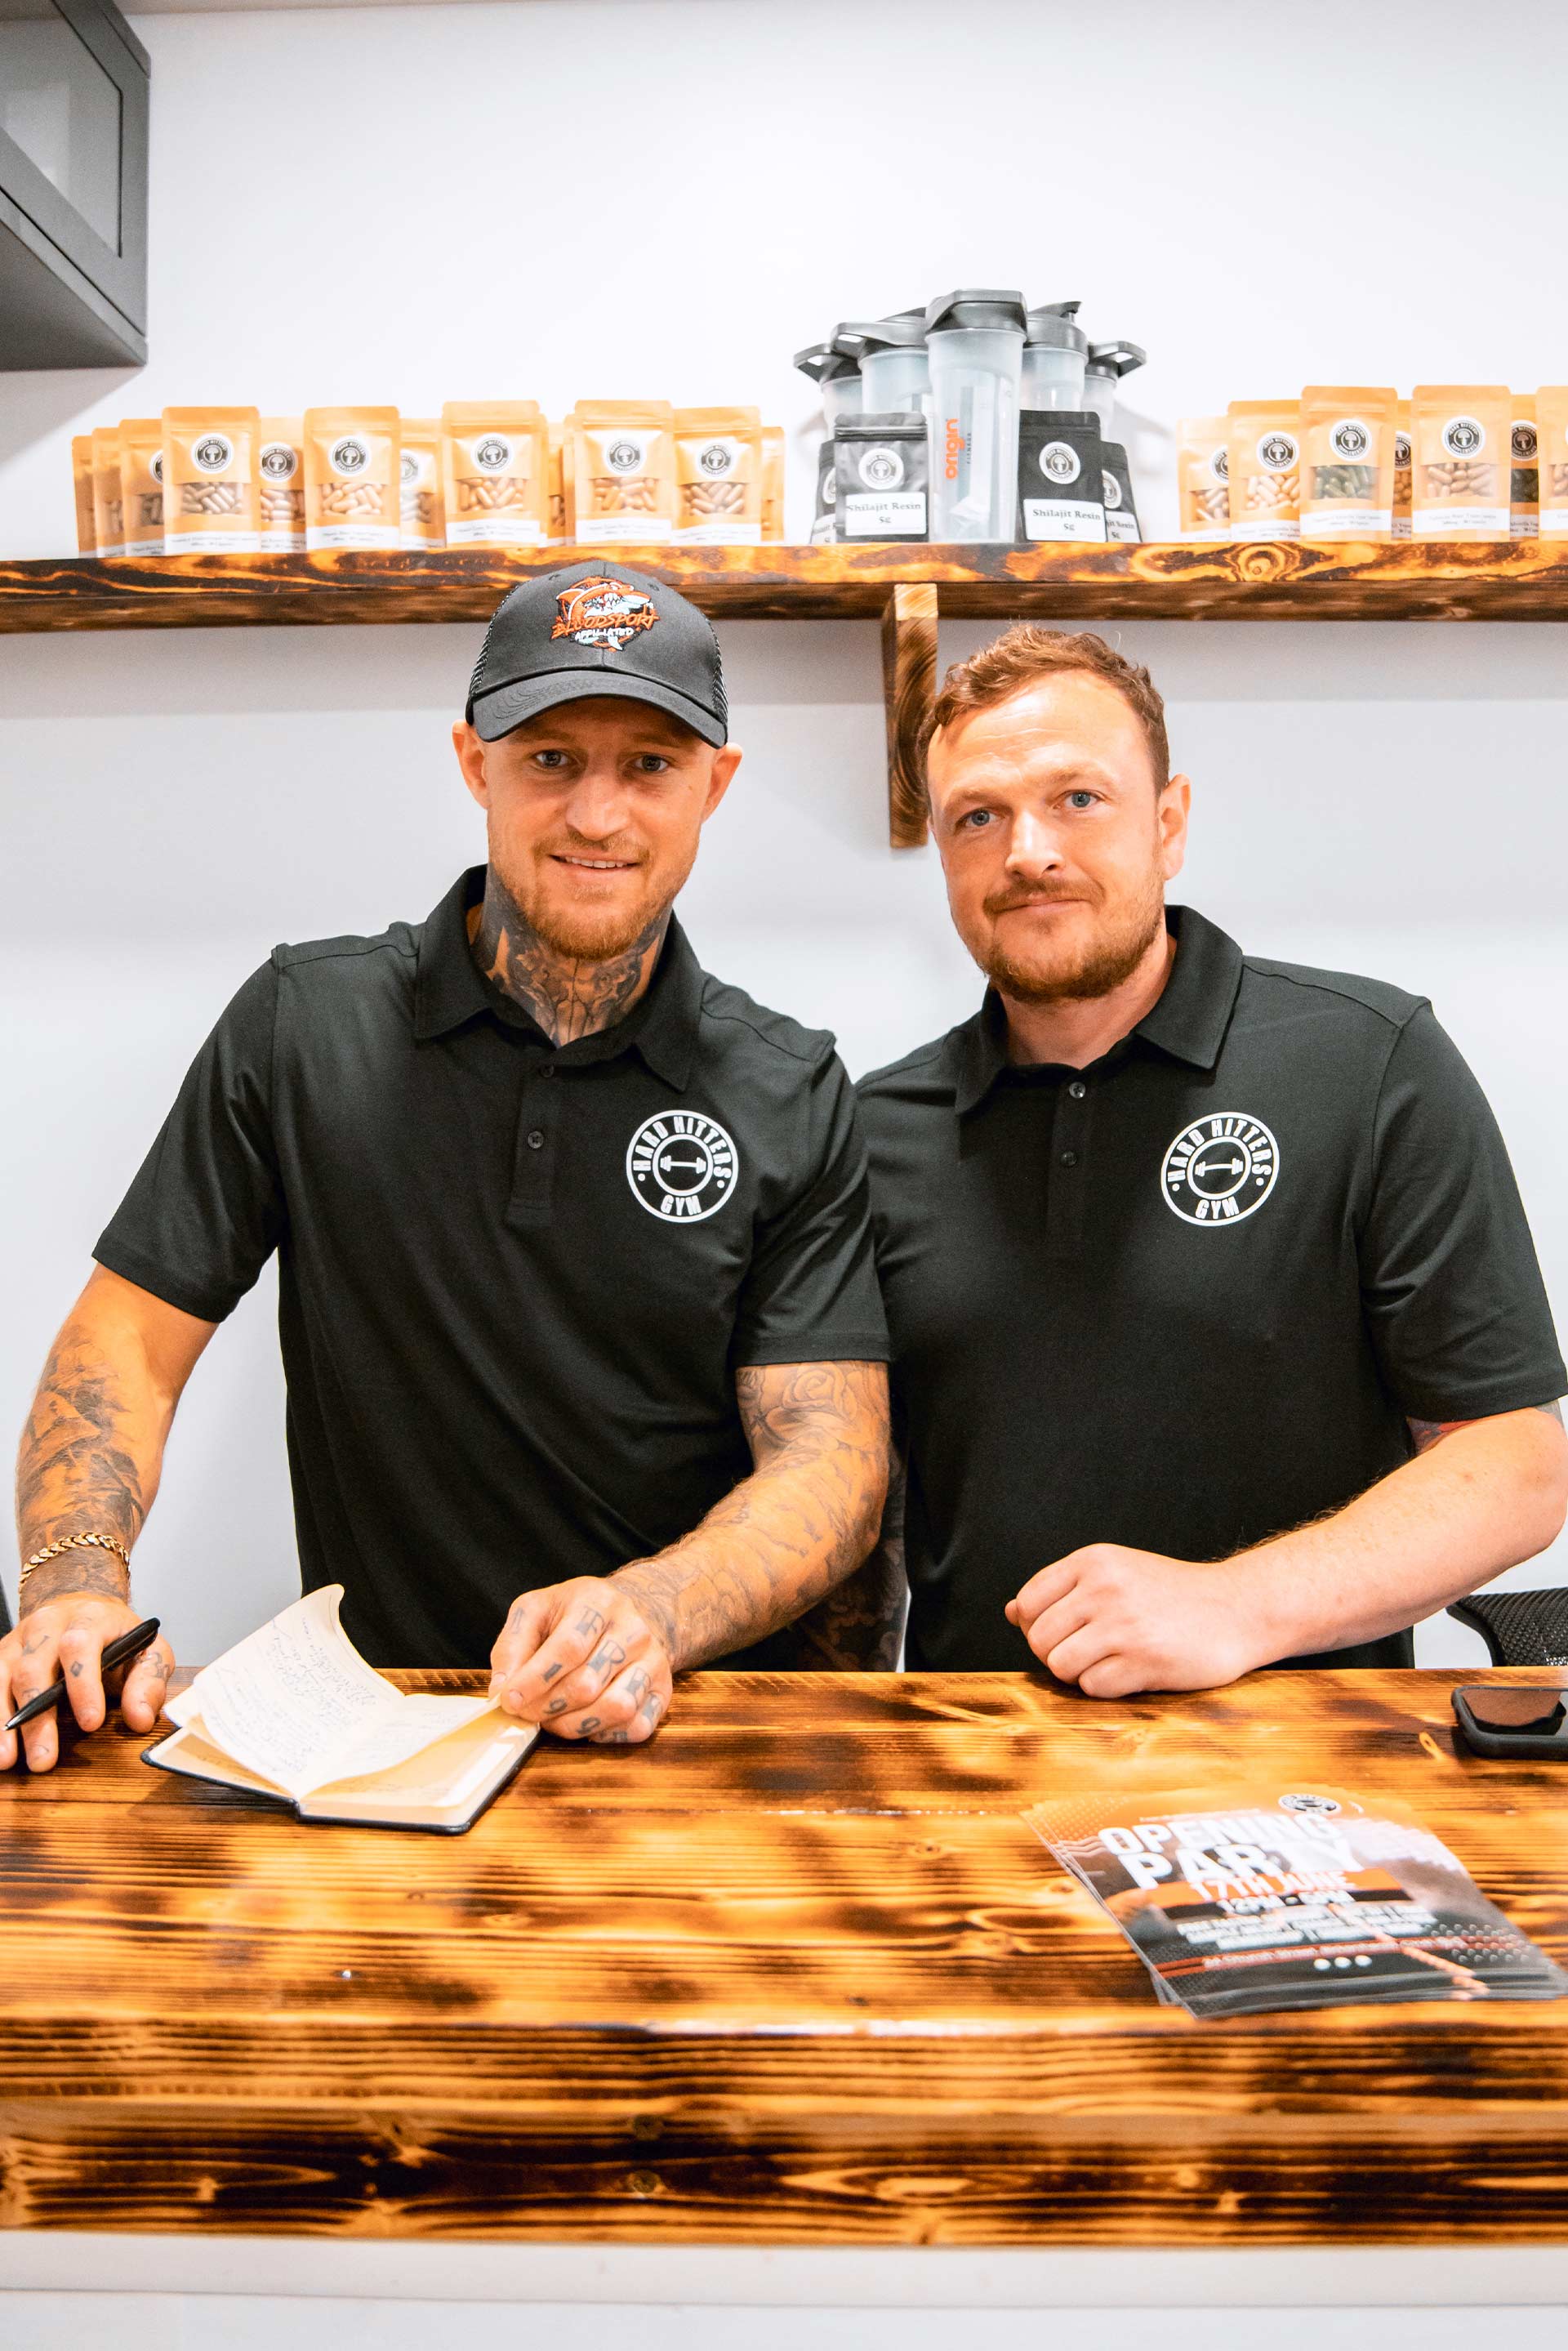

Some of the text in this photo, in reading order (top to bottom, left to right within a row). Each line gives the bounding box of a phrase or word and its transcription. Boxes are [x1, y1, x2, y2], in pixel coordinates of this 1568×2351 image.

[945, 417, 965, 480] origin
[848, 502, 921, 511] Shilajit Resin
[1033, 509, 1100, 520] Shilajit Resin
[550, 610, 660, 640] BLOODSPORT
[575, 627, 634, 640] AFFILIATED
[633, 1116, 733, 1179] HARD HITTERS
[1167, 1118, 1272, 1182] HARD HITTERS
[660, 1194, 702, 1216] GYM
[1195, 1196, 1240, 1220] GYM
[1098, 1813, 1343, 1854] OPENING
